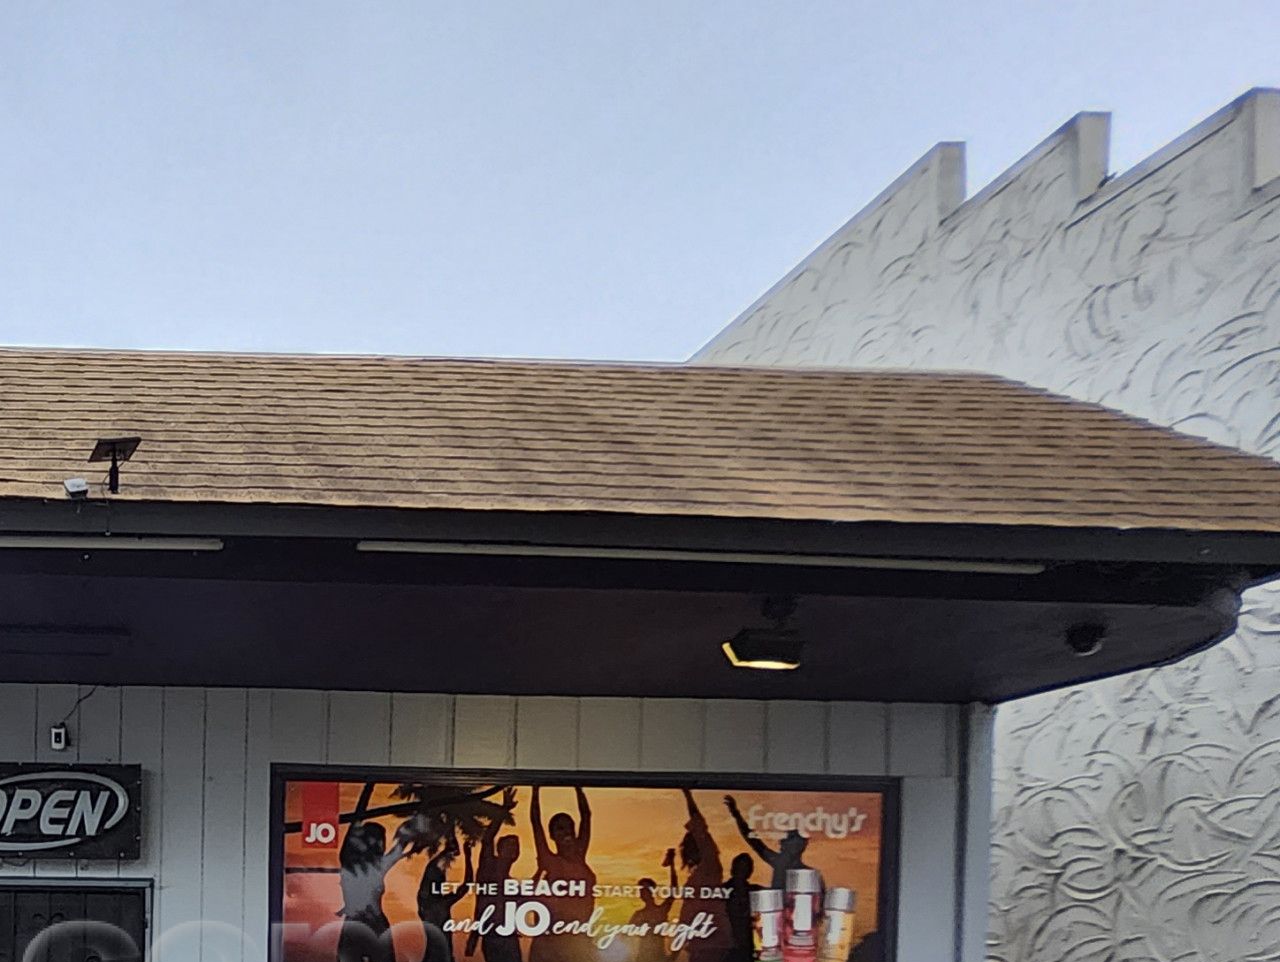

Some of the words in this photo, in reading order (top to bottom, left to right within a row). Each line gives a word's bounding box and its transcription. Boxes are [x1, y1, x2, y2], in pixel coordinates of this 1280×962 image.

[305, 822, 336, 844] JO
[747, 804, 868, 839] Frenchy's
[431, 881, 459, 895] LET
[465, 882, 498, 896] THE
[503, 878, 586, 897] BEACH
[591, 884, 645, 898] START
[648, 885, 695, 899] YOUR
[699, 886, 734, 899] DAY
[442, 904, 496, 936] and
[495, 900, 551, 937] JO
[552, 906, 604, 938] end
[596, 921, 651, 950] your
[653, 911, 718, 951] night
